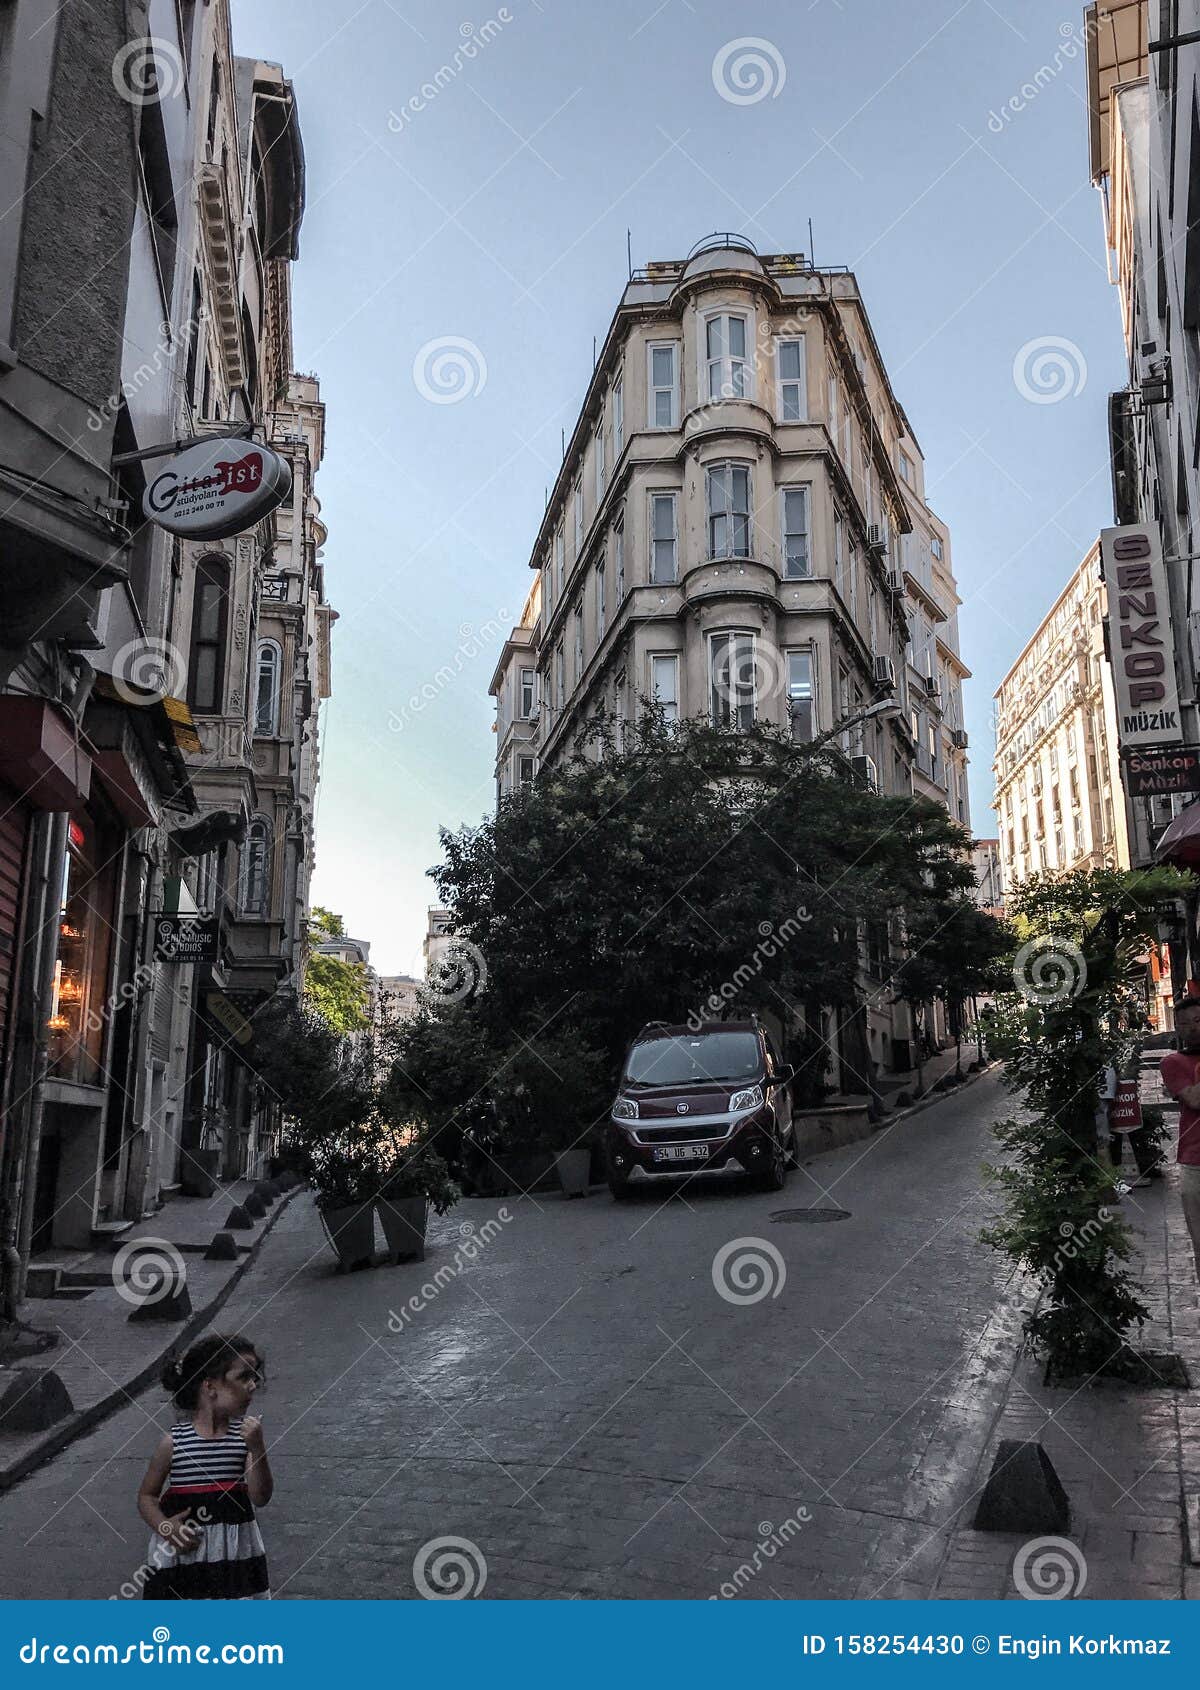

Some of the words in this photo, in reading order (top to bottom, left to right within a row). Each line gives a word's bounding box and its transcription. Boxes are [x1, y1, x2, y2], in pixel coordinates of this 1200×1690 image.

[149, 464, 258, 512] Gitarist
[174, 508, 190, 518] 0212
[205, 502, 215, 510] 00
[1113, 534, 1165, 707] SENKOP
[1123, 709, 1178, 733] MÜZİK
[1130, 757, 1196, 773] Senkop
[161, 933, 186, 943] VENUS
[187, 933, 212, 943] MUSIC
[170, 942, 202, 952] STUDIOS
